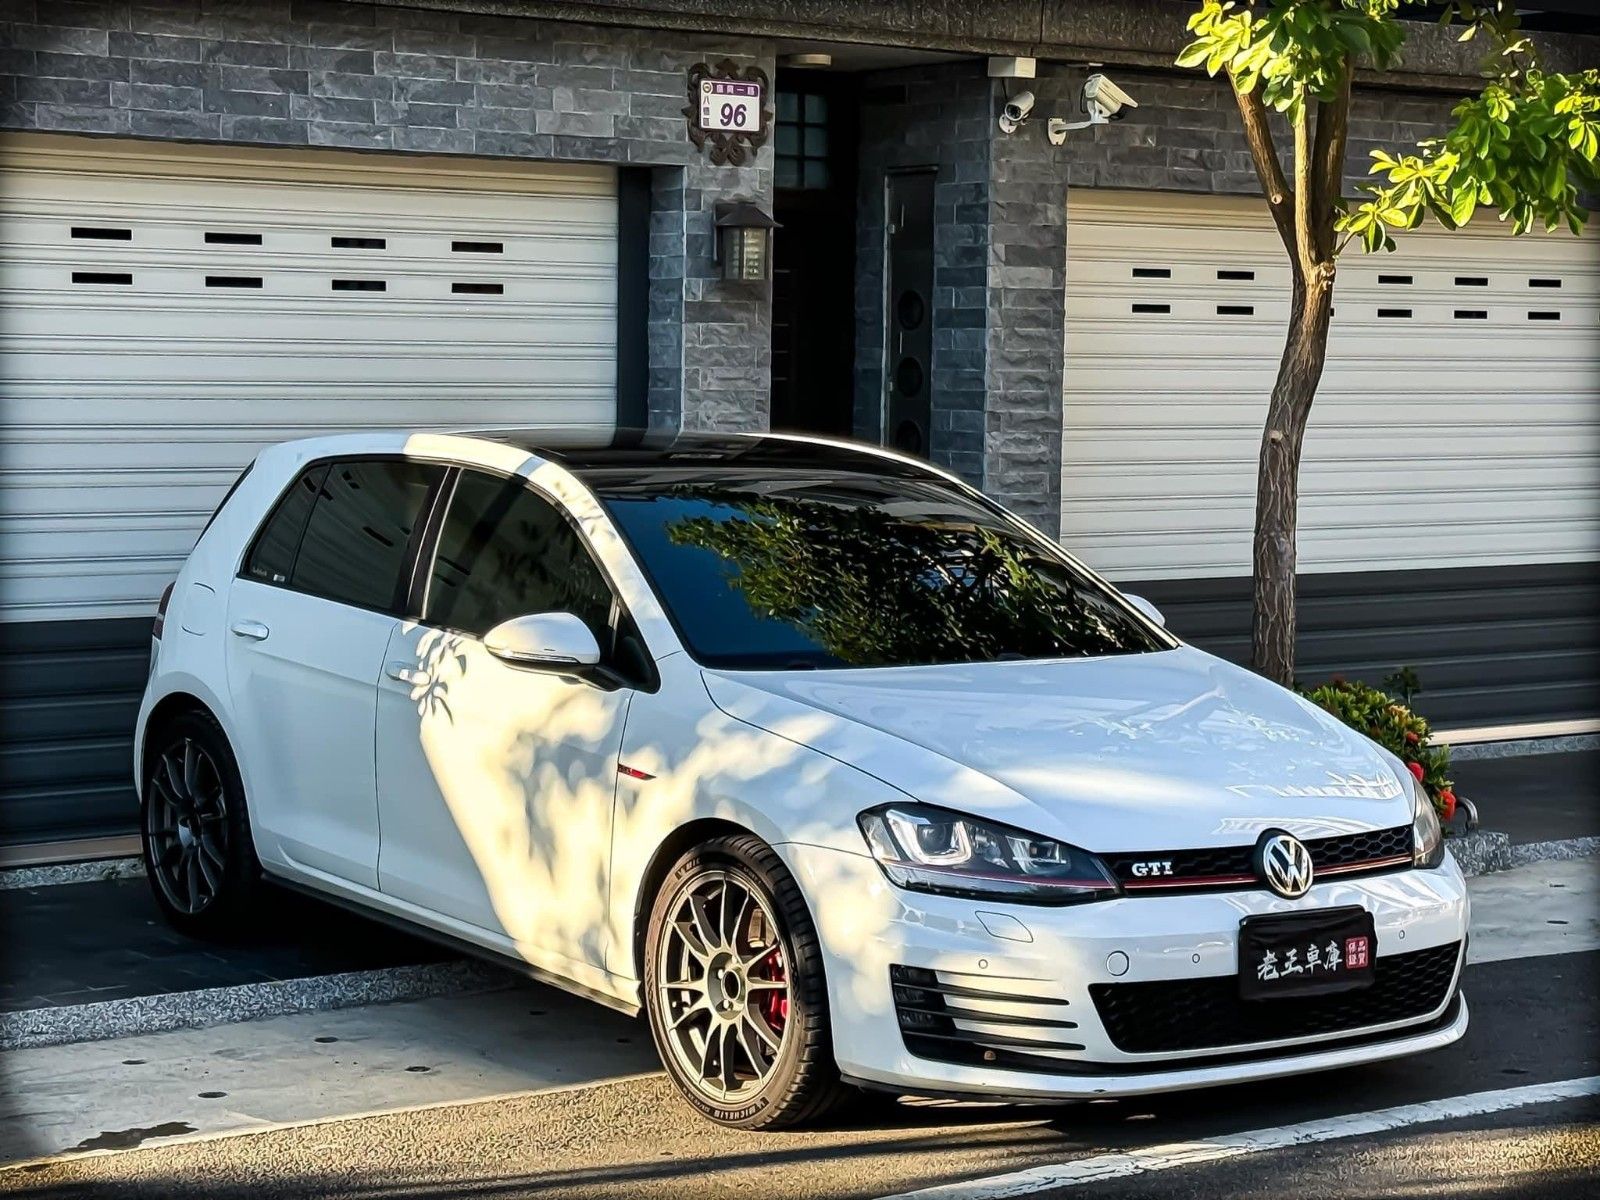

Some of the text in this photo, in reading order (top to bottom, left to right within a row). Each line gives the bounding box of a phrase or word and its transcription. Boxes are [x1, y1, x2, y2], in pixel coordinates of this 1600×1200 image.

[720, 102, 747, 127] 96
[1131, 861, 1174, 877] GTI
[1257, 940, 1343, 981] 老王車庫
